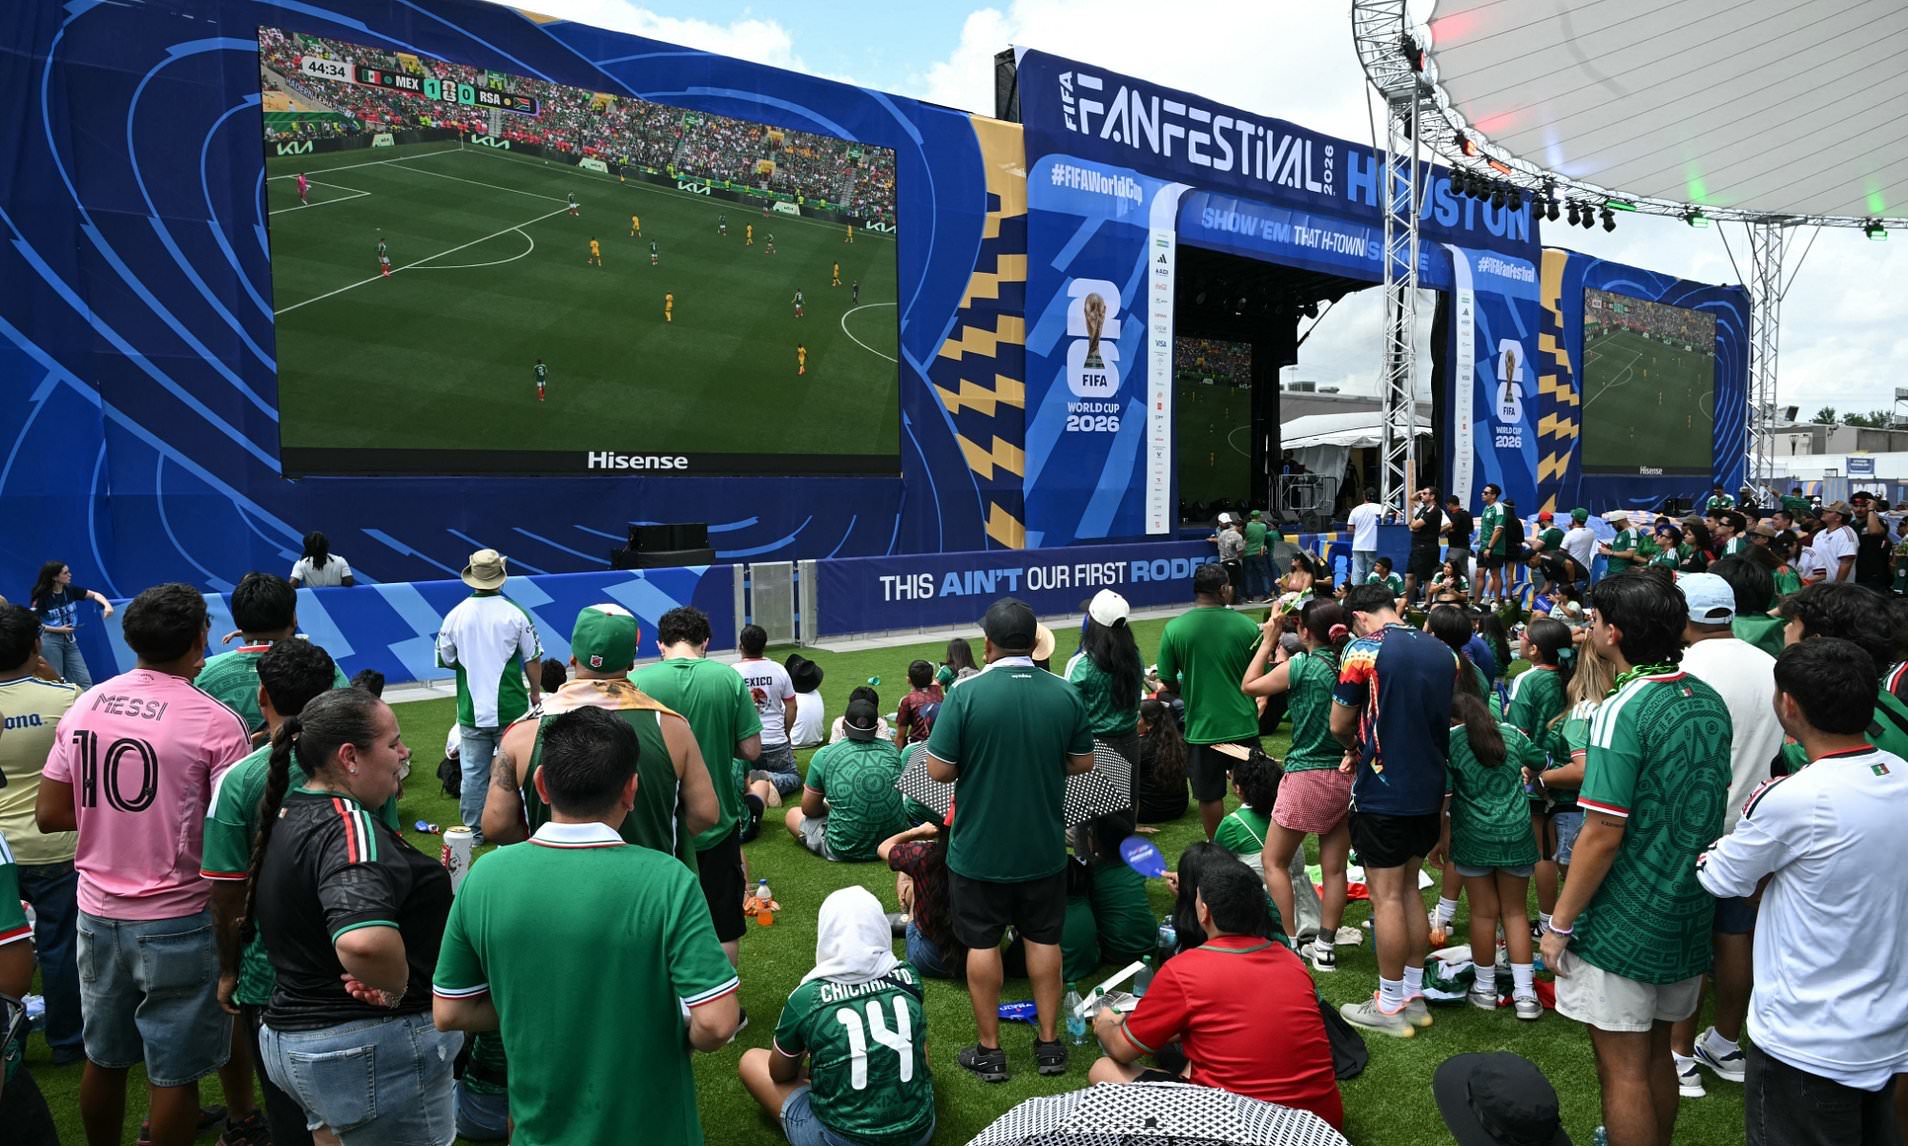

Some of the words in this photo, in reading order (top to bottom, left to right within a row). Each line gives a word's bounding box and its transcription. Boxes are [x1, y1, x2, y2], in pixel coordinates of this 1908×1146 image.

[308, 61, 346, 78] 44:34
[395, 75, 420, 90] MEX
[428, 82, 436, 95] 1
[462, 88, 471, 99] 0
[480, 91, 501, 105] RSA
[1059, 71, 1078, 132] FIFA
[1323, 144, 1335, 196] 2026
[1051, 163, 1143, 207] #FIFAWorldCup
[1202, 207, 1258, 237] SHOW
[1259, 221, 1290, 244] 'EM
[1294, 225, 1322, 250] THAT
[1322, 231, 1366, 258] H-TOWN
[1082, 374, 1108, 388] FIFA
[1067, 401, 1103, 414] WORLD
[1103, 402, 1120, 414] CUP
[1503, 406, 1516, 417] FIFA
[1066, 415, 1120, 433] 2026
[1496, 426, 1513, 435] WORLD
[1513, 427, 1522, 436] CUP
[1496, 435, 1522, 449] 2026
[587, 451, 689, 469] Hisense
[1640, 466, 1663, 475] Hisense
[880, 573, 934, 602] THIS
[939, 568, 1024, 597] AIN'T
[1027, 564, 1071, 591] OUR
[1075, 561, 1128, 587] FIRST
[744, 676, 773, 688] EXICO
[91, 692, 169, 722] MESSI
[72, 730, 159, 813] 10
[836, 995, 914, 1091] 14
